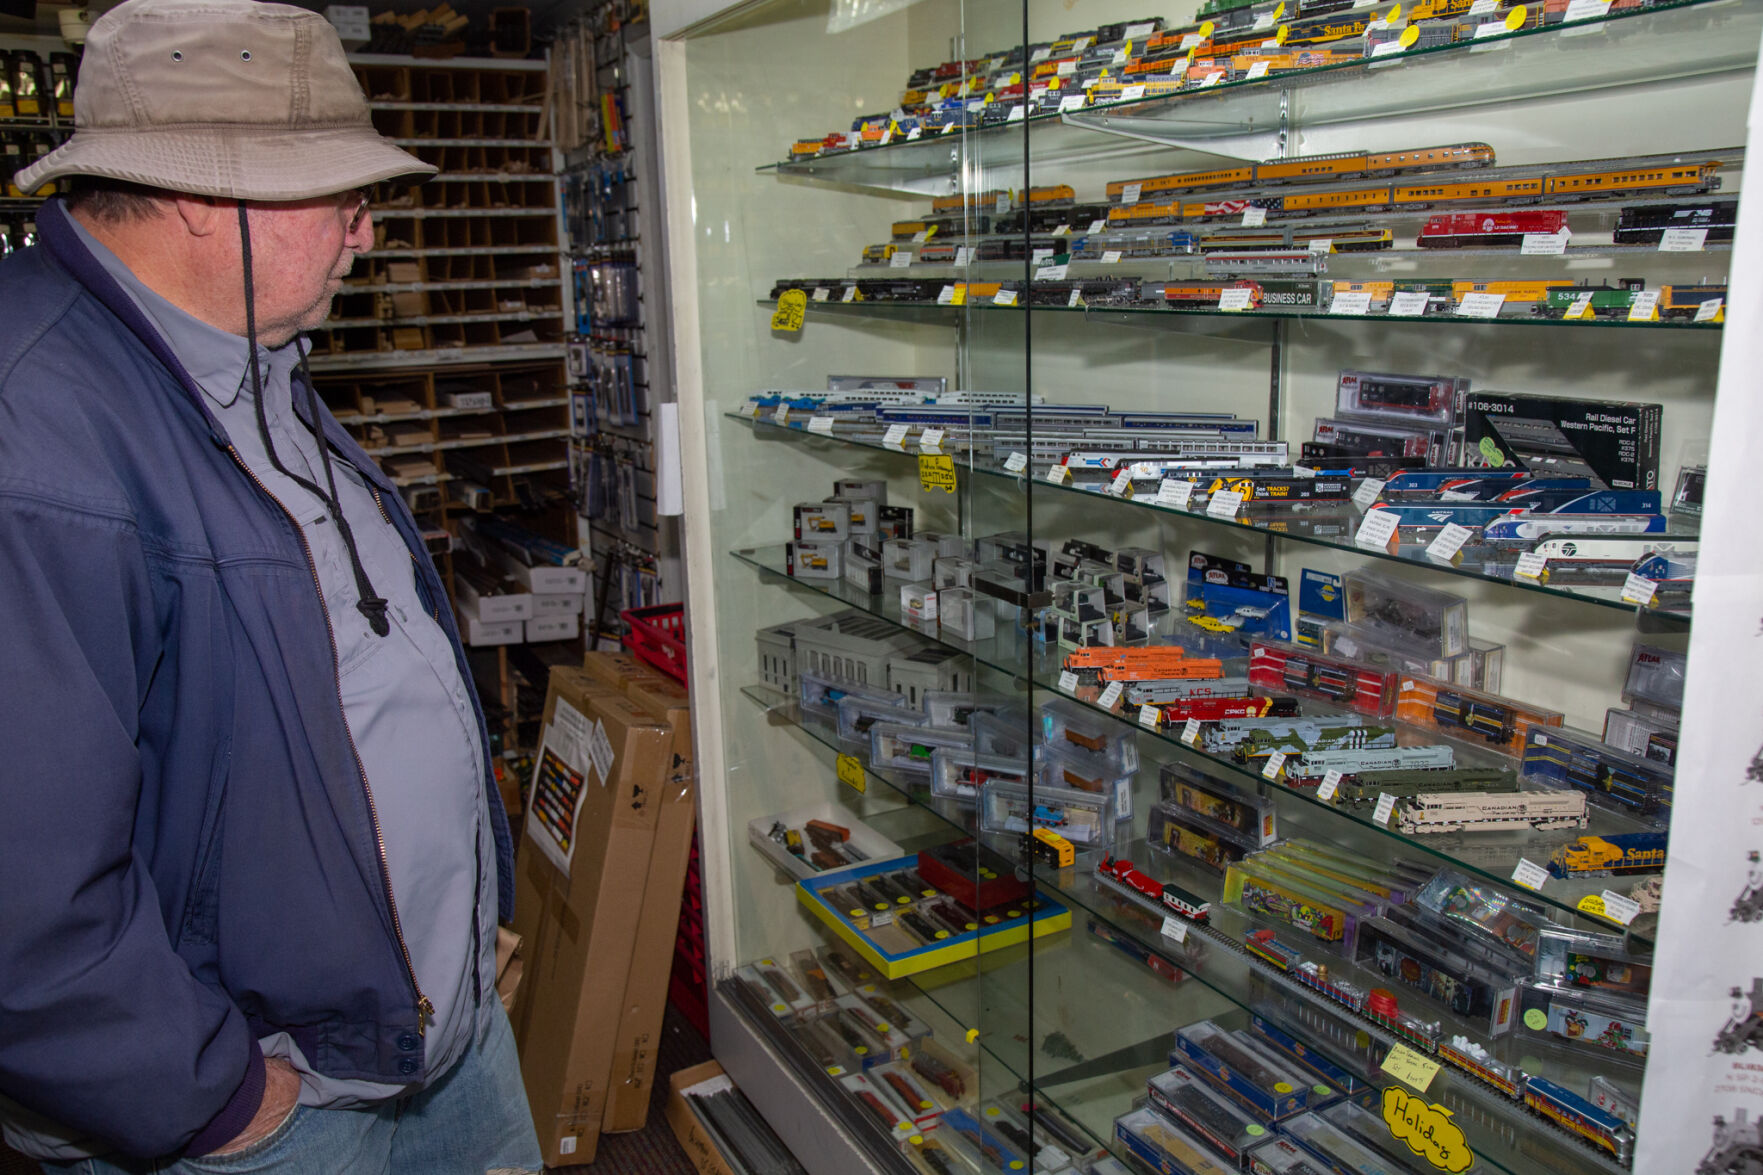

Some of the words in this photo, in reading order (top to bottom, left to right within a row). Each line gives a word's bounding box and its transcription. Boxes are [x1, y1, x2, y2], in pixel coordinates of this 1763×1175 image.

[1324, 23, 1352, 36] Santa
[1263, 292, 1297, 304] BUSINESS
[1298, 292, 1312, 304] CAR
[1468, 402, 1514, 414] #106-3014
[1585, 412, 1599, 422] Rail
[1600, 414, 1622, 424] Diesel
[1623, 416, 1637, 425] Car
[1560, 419, 1588, 430] Western
[1588, 422, 1615, 434] Pacific,
[1616, 424, 1630, 435] Set
[1630, 426, 1637, 435] F
[1637, 652, 1661, 664] ATLAS
[1189, 687, 1212, 697] KCS
[1626, 847, 1665, 860] Santa
[1393, 1095, 1451, 1160] Holiday
